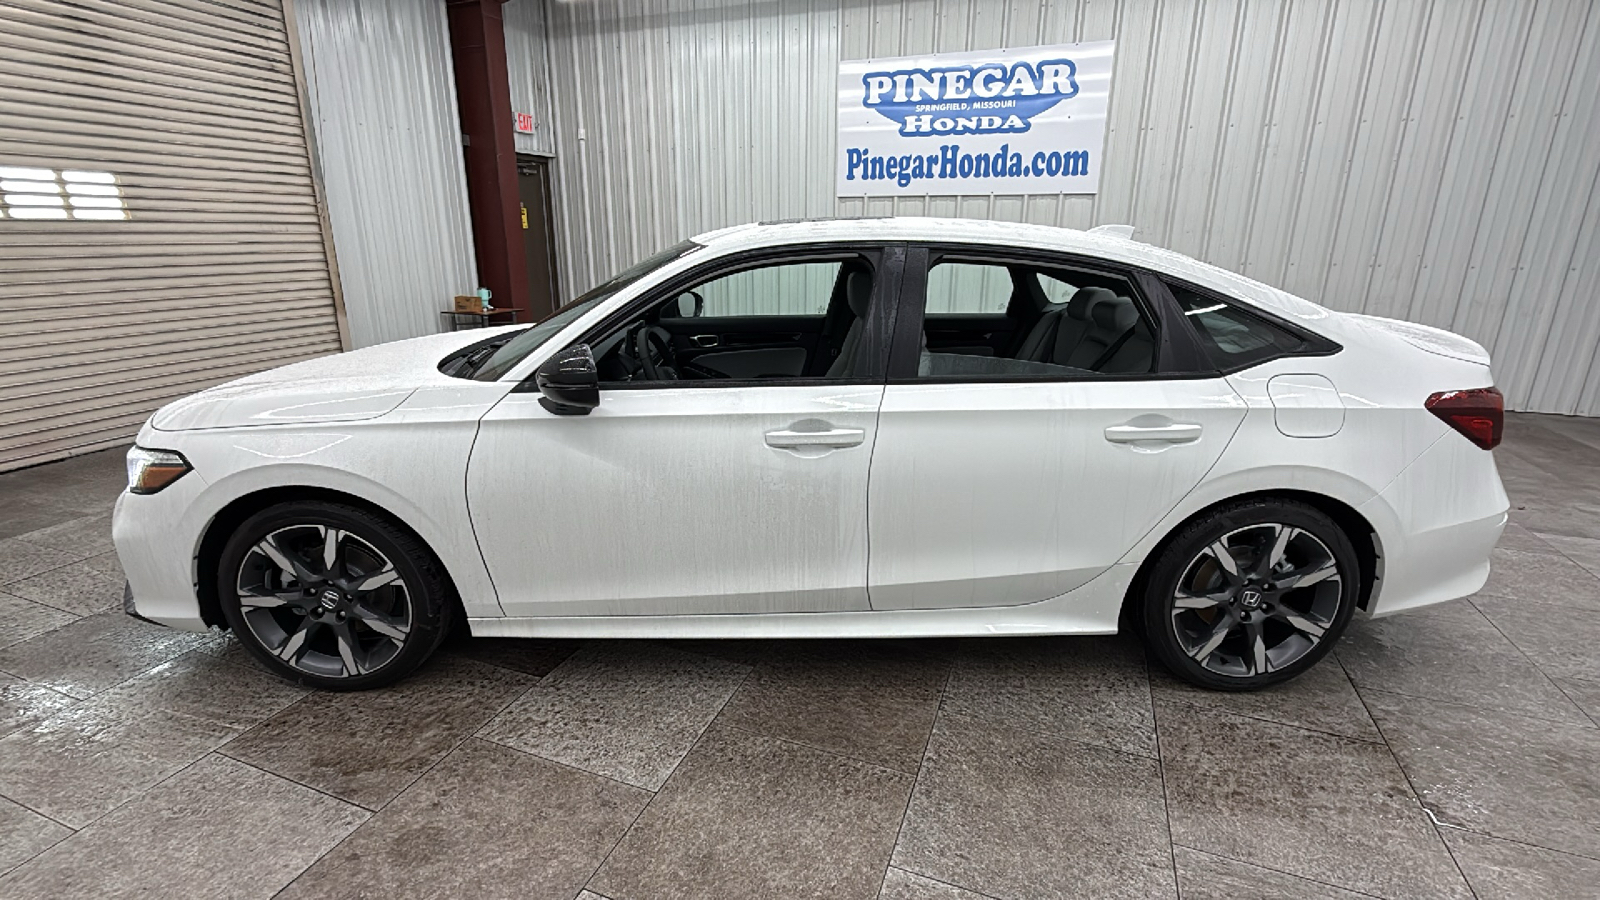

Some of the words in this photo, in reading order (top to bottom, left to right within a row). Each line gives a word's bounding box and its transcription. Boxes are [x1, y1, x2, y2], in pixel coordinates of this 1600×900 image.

[865, 63, 1074, 104] PINEGAR
[915, 102, 970, 112] SPRINGFIELD,
[972, 99, 1016, 110] MISSOURI
[518, 112, 532, 131] EXIT
[902, 114, 1027, 132] HONDA
[846, 143, 1090, 188] PinegarHonda.com
